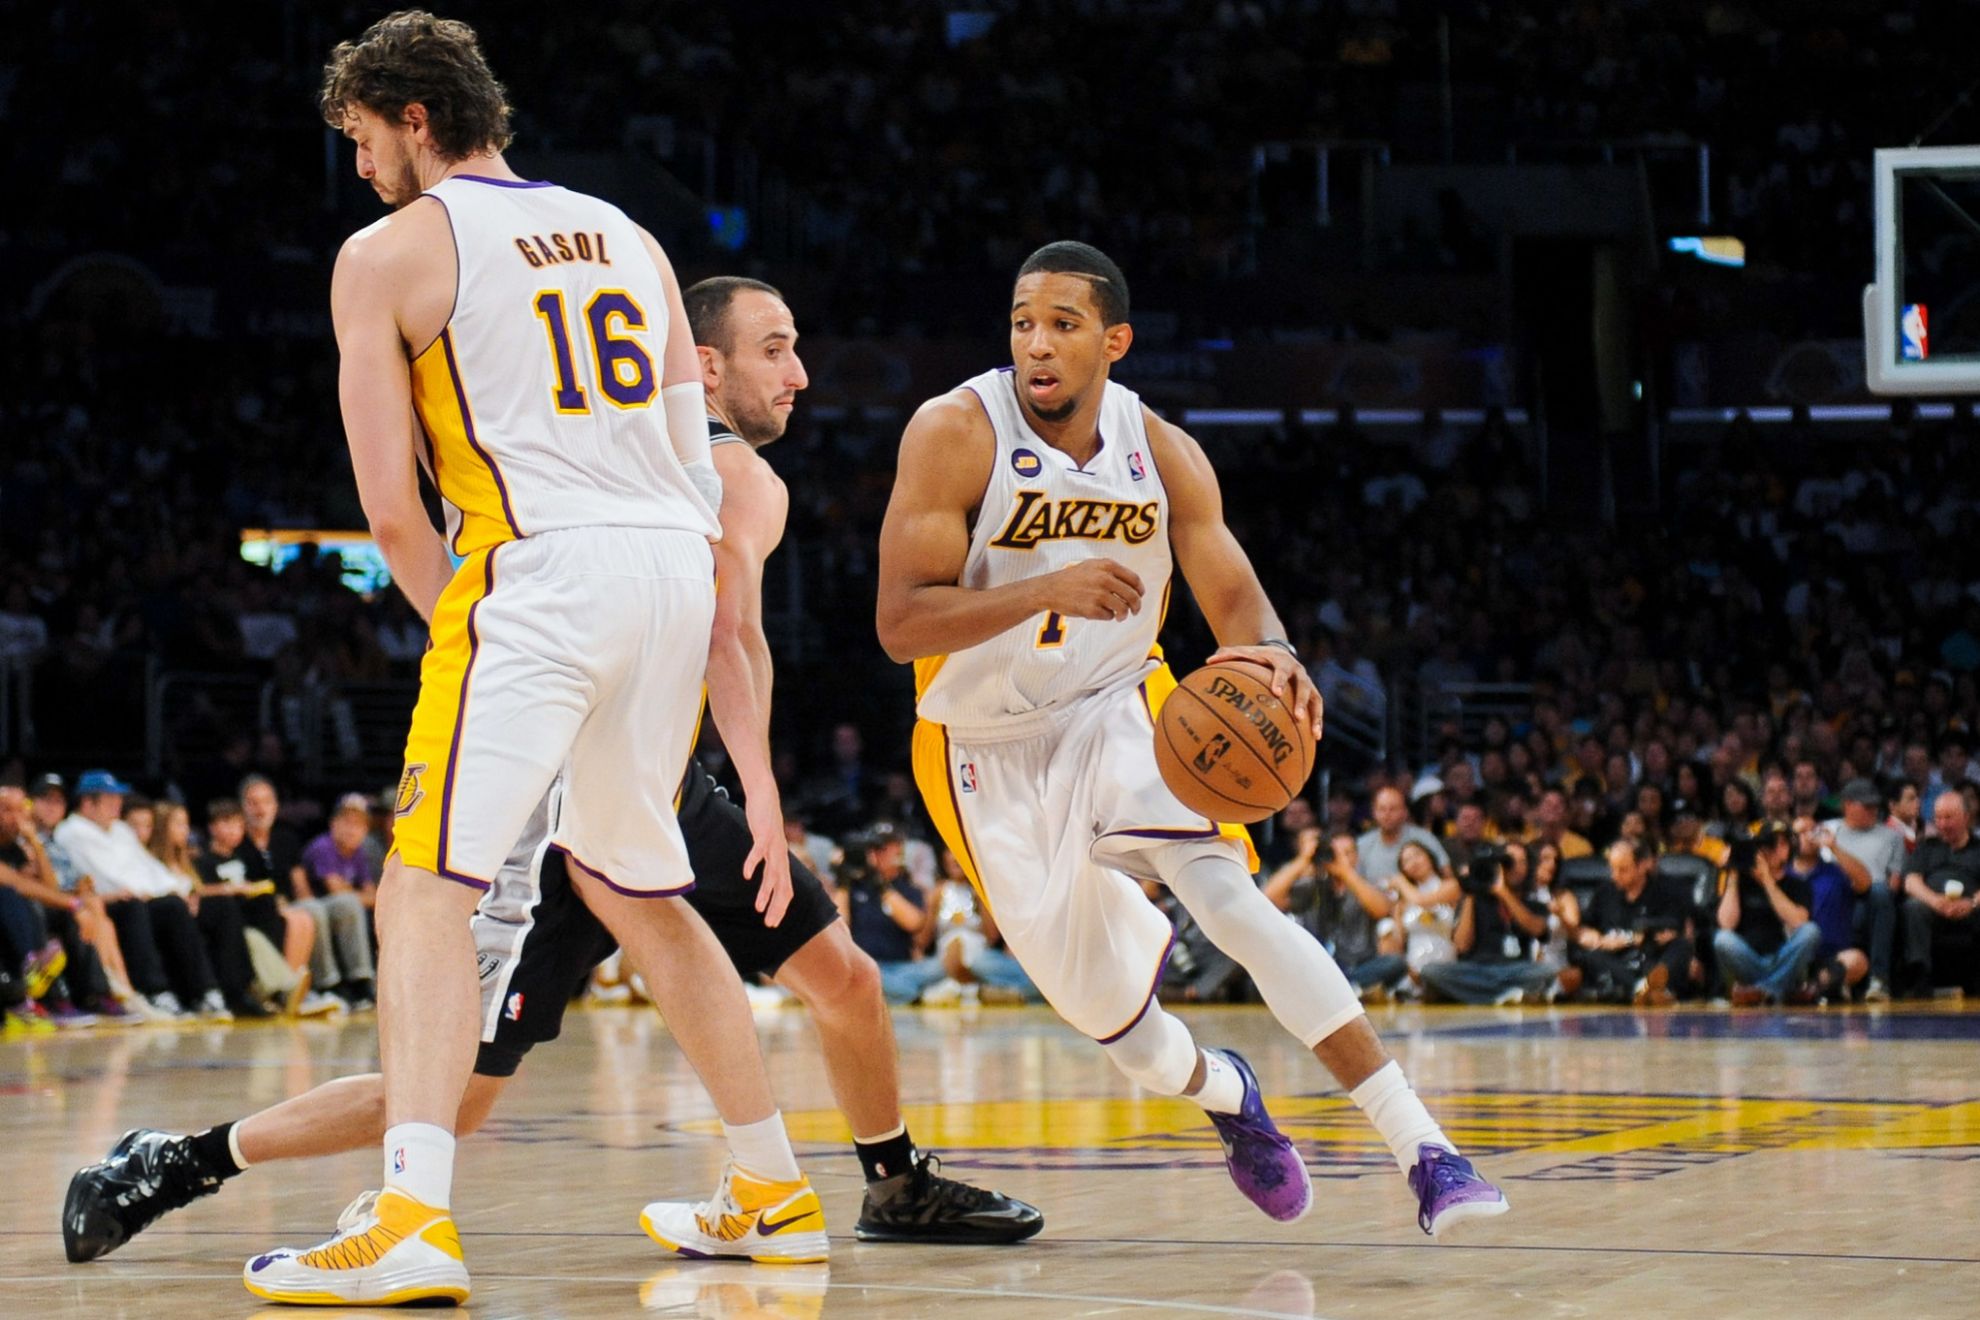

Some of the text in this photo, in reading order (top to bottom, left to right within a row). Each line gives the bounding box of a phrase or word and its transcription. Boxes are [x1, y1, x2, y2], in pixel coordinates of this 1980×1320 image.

[513, 231, 612, 269] GASOL
[532, 288, 658, 415] 16
[988, 489, 1159, 551] LAKERS
[1205, 676, 1294, 768] SPALDING
